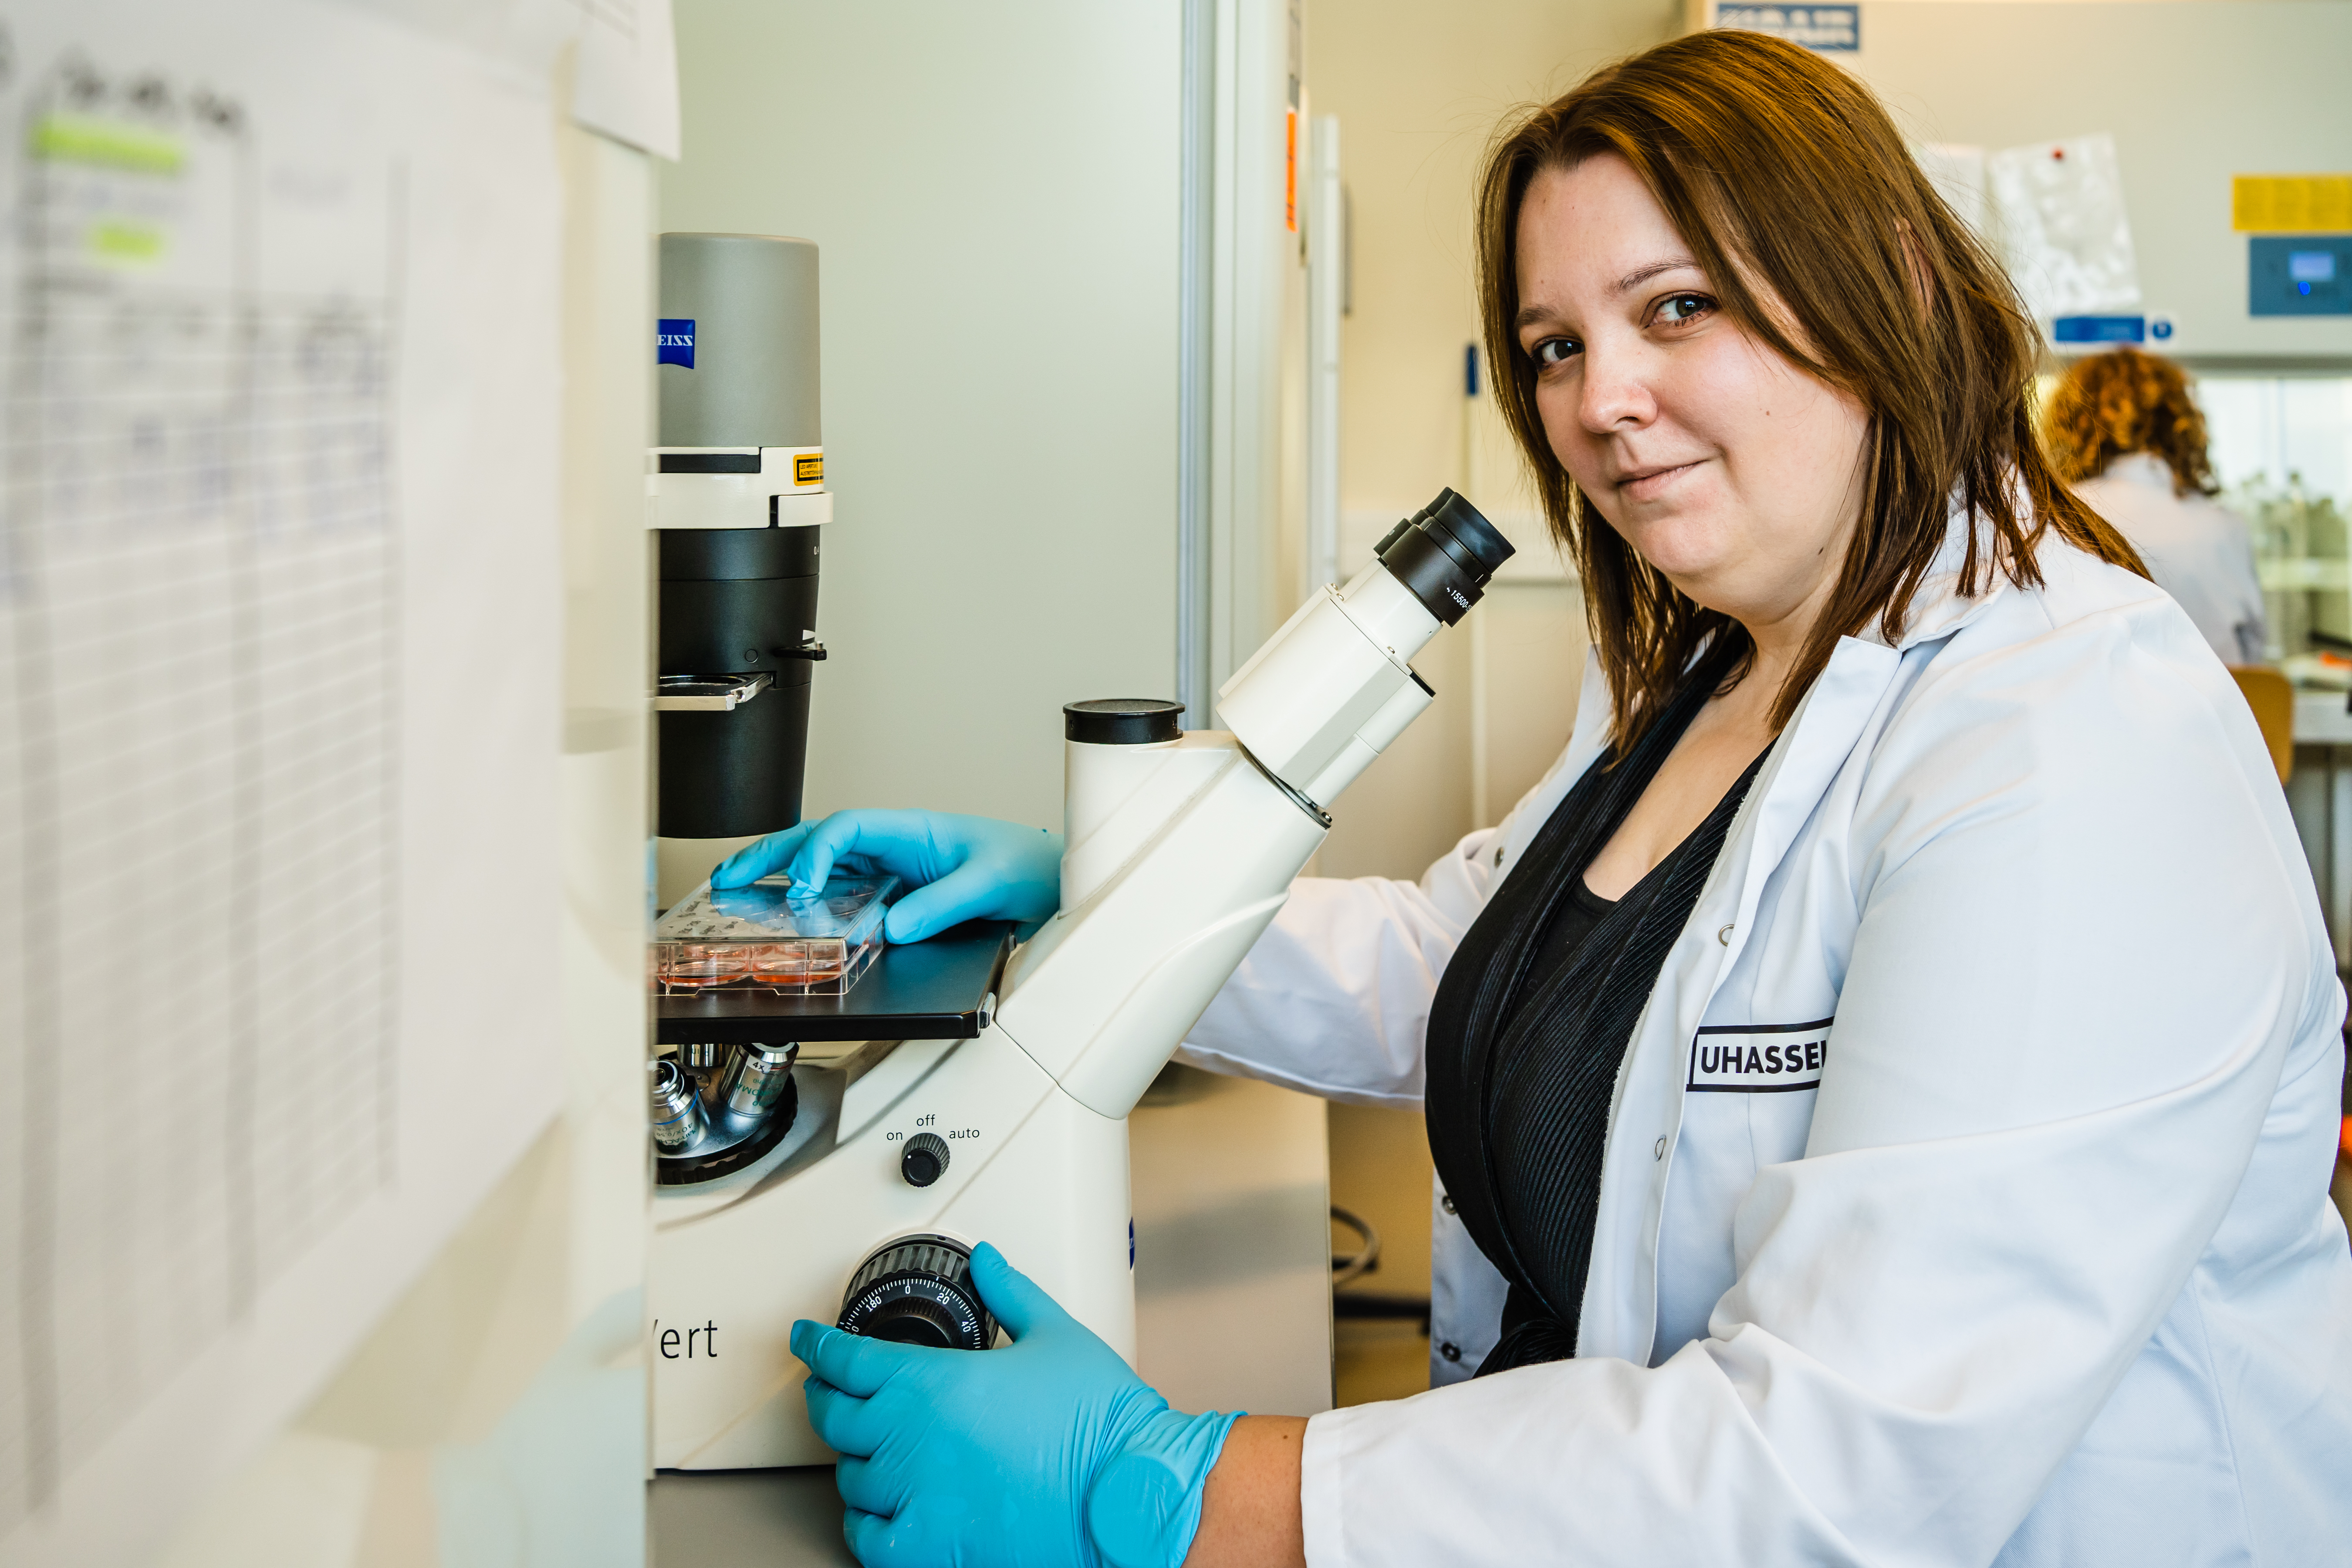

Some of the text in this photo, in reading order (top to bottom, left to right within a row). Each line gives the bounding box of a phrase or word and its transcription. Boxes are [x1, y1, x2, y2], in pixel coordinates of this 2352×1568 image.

[916, 1114, 936, 1126] off
[886, 1132, 903, 1140] on
[949, 1128, 980, 1139] auto
[905, 1285, 911, 1294] 0
[865, 1295, 882, 1312] 180
[936, 1292, 950, 1305] 20
[961, 1320, 972, 1332] 40
